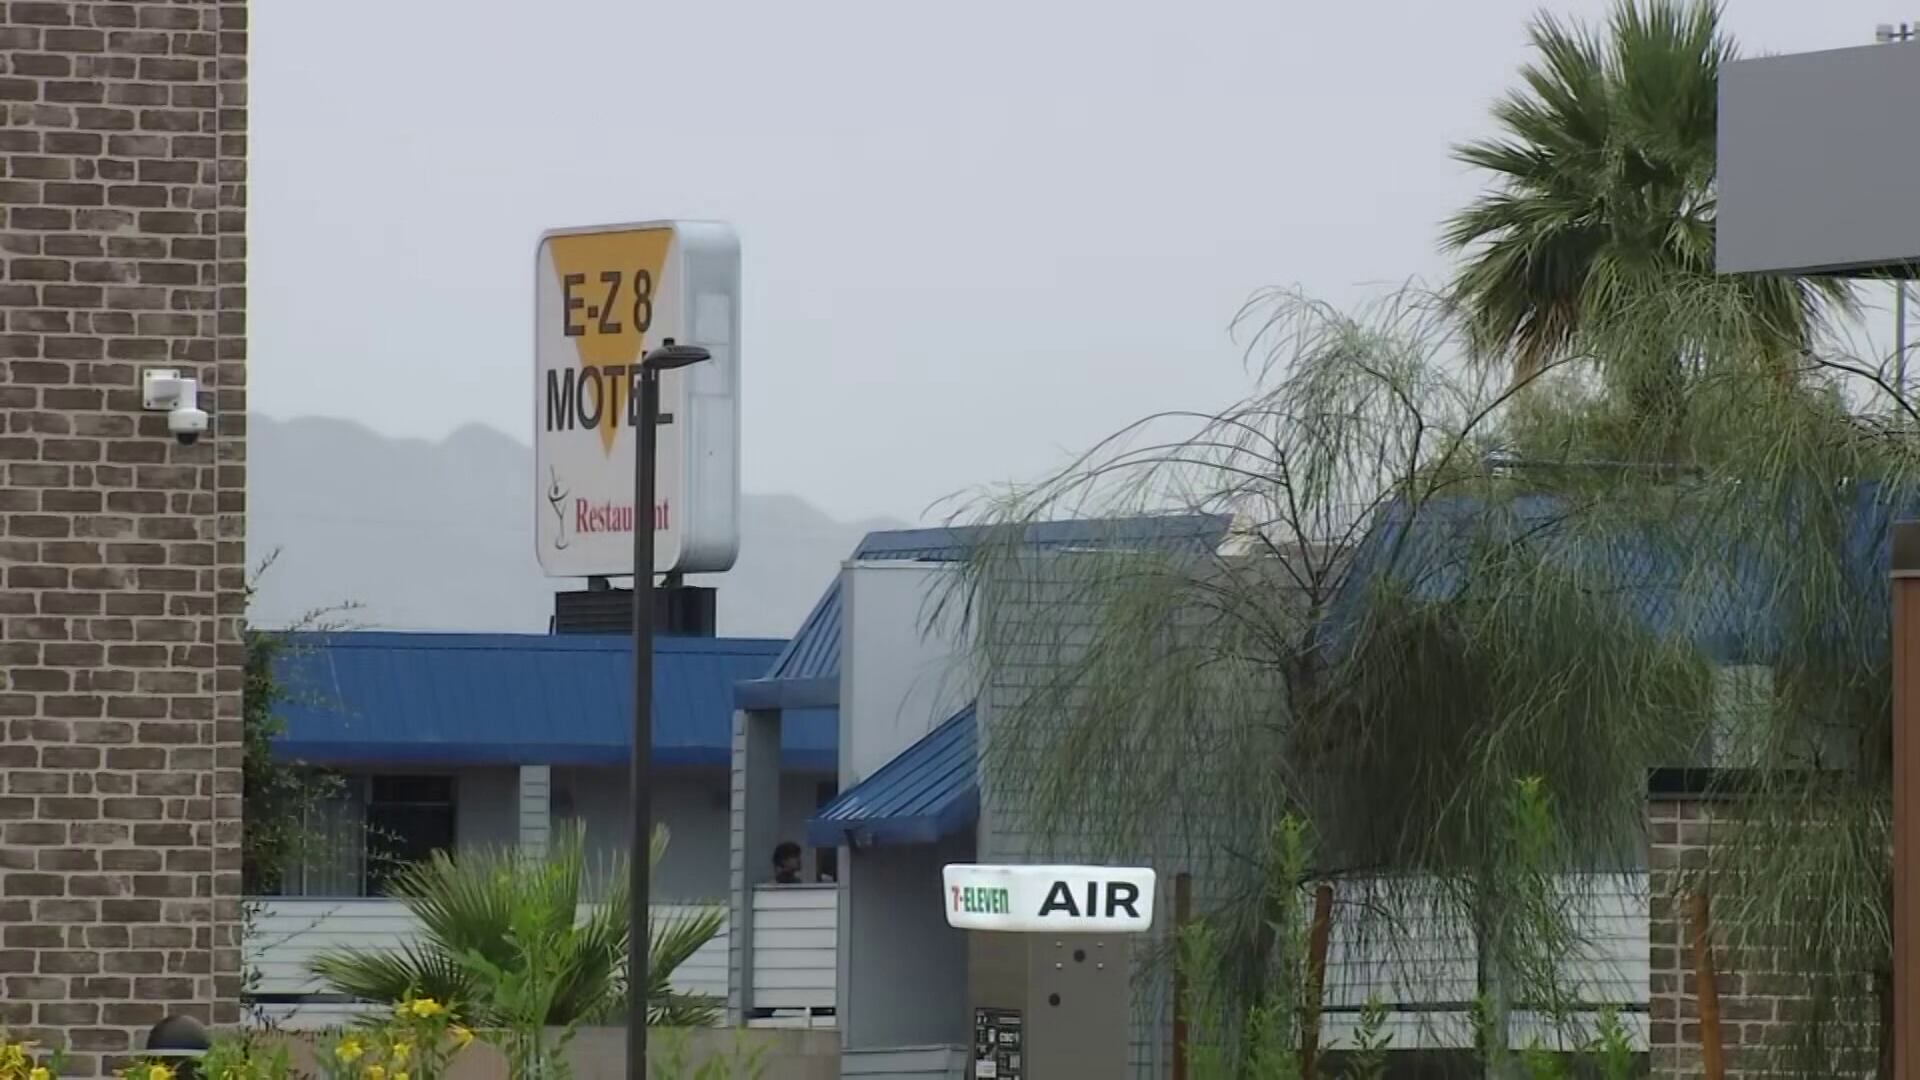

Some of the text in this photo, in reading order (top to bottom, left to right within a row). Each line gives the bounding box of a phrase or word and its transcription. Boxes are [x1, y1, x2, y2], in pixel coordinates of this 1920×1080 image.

[563, 269, 652, 336] E-Z 8
[576, 497, 669, 533] Restaunt
[1038, 881, 1141, 918] AIR
